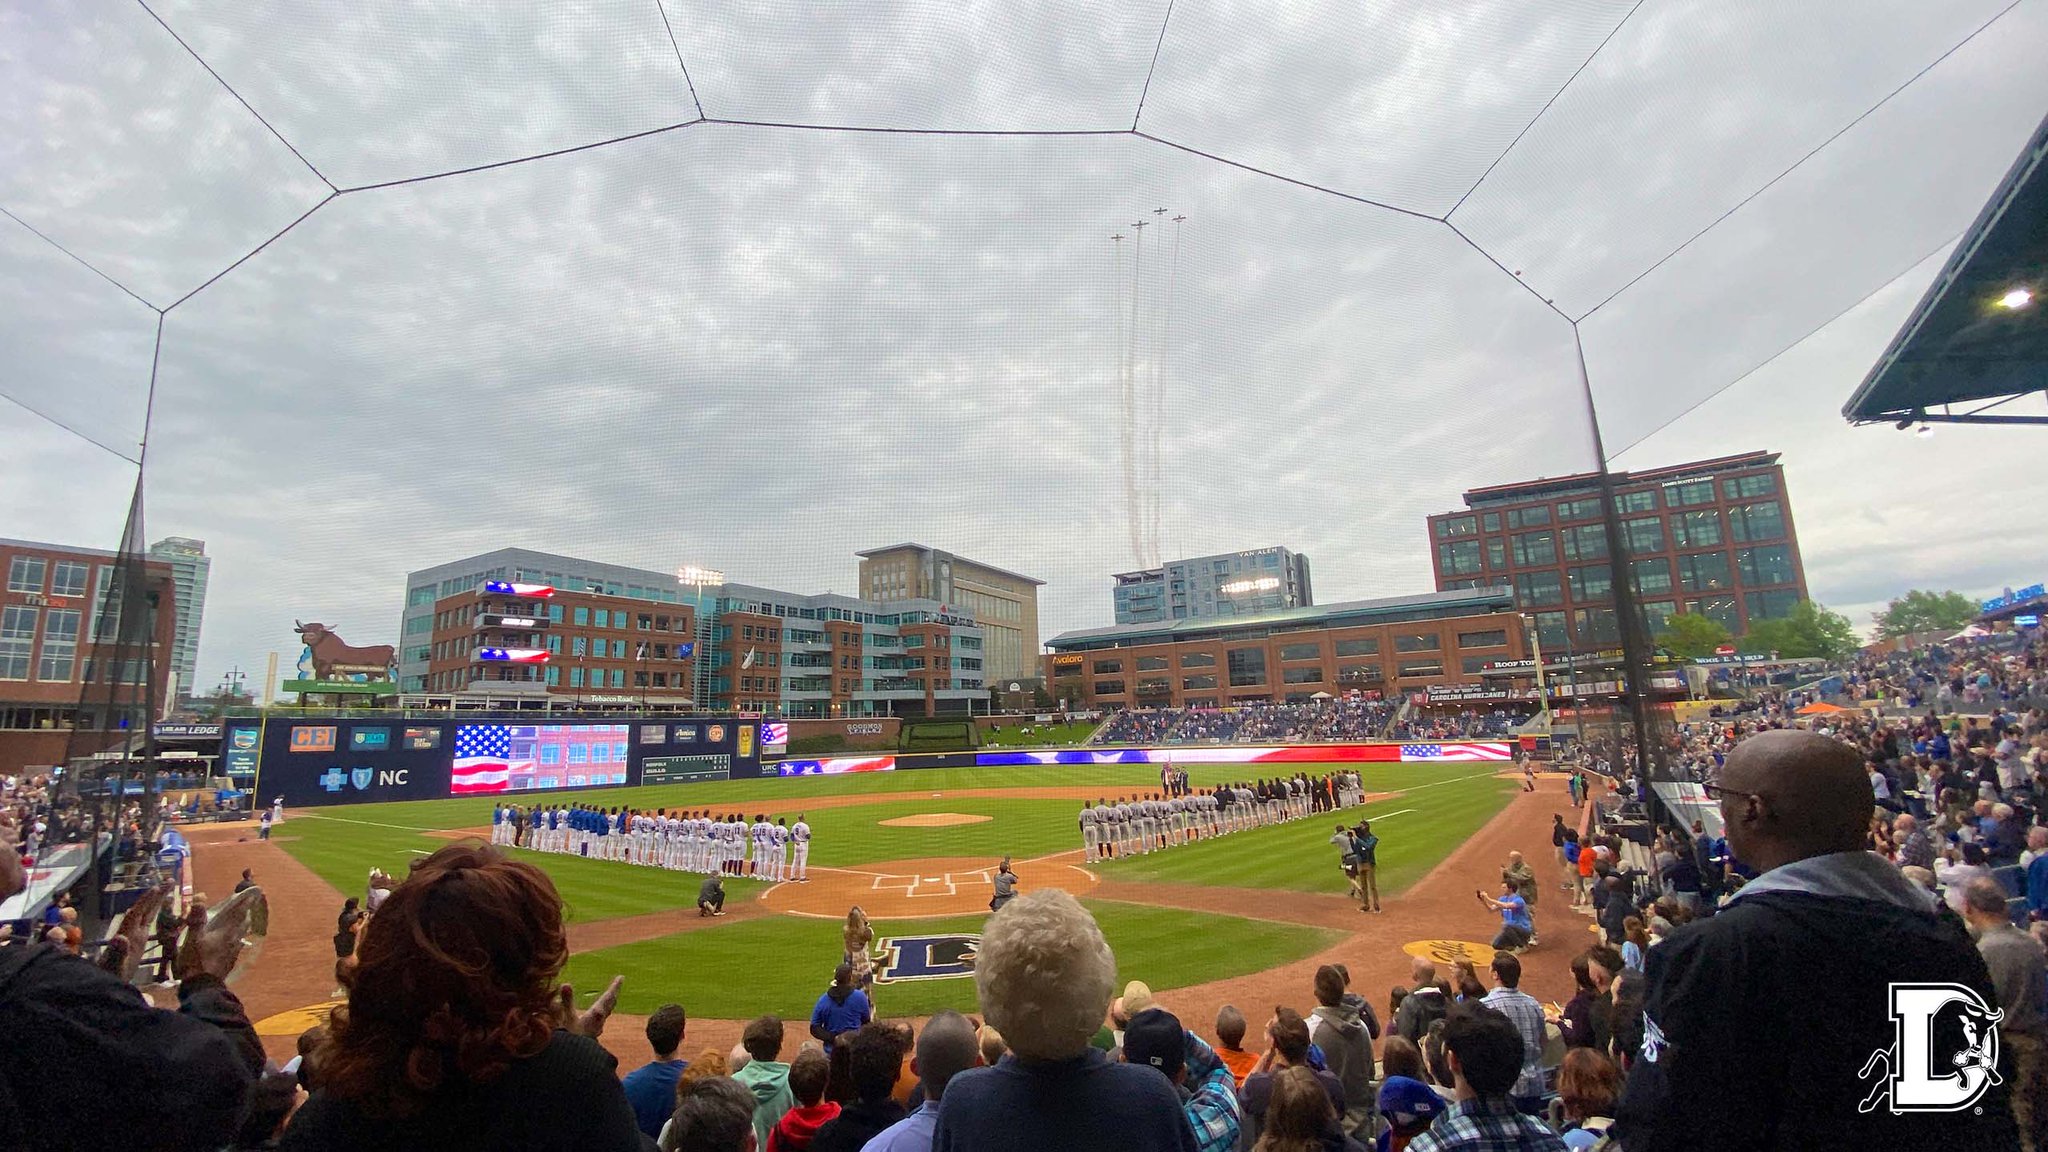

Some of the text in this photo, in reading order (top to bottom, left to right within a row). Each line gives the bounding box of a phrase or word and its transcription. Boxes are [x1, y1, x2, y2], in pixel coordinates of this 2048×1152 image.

[1052, 654, 1083, 665] Avalara
[1494, 659, 1519, 668] ROOF
[1430, 691, 1506, 701] CAROLINA HURRICANES
[188, 726, 220, 735] LEDGE
[292, 728, 336, 746] CEI
[379, 769, 409, 786] NC
